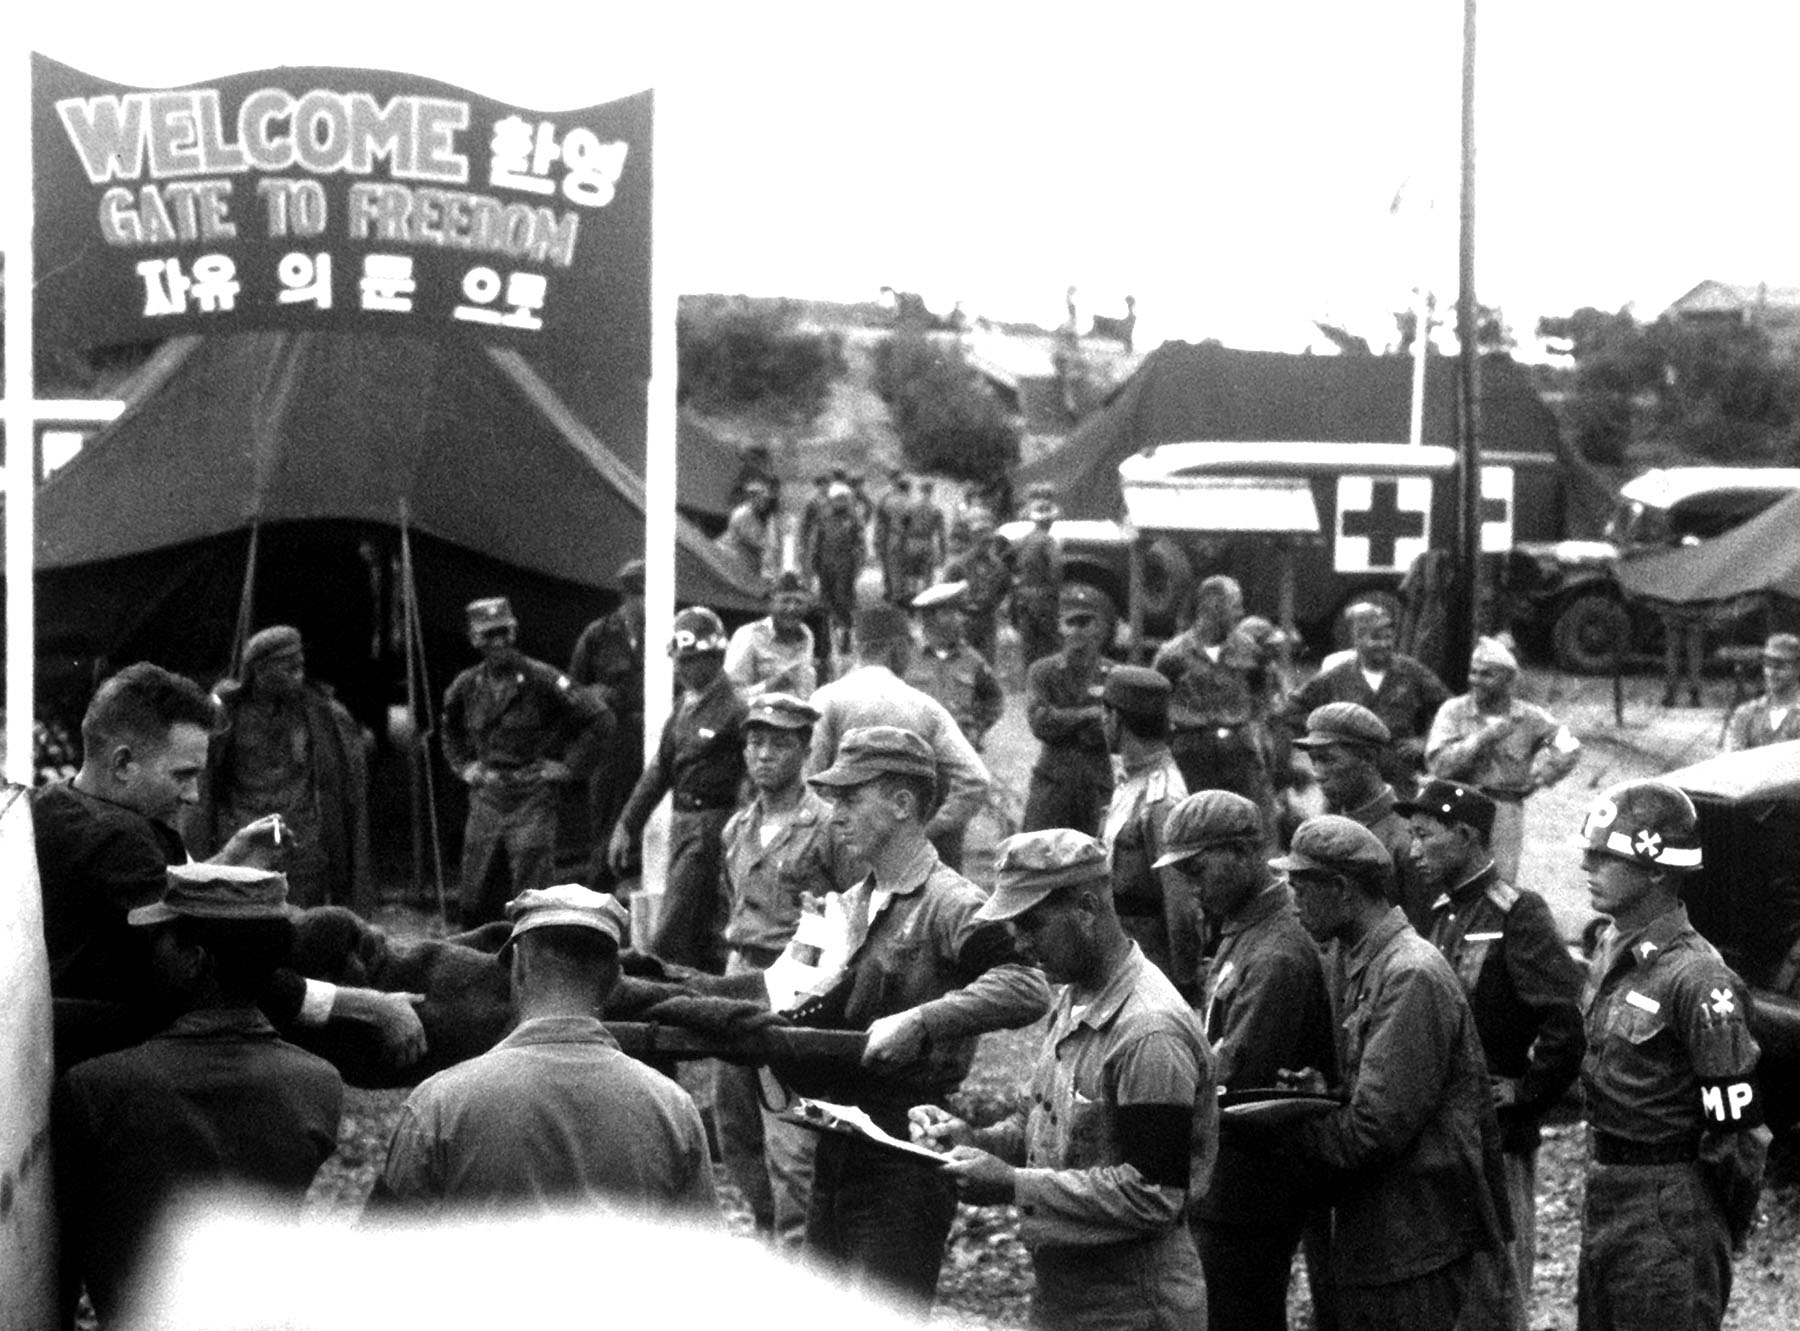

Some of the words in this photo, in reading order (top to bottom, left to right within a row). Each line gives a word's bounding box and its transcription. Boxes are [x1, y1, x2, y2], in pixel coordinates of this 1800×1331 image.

[56, 88, 470, 182] WELCOME
[490, 115, 629, 207] 환영
[100, 178, 236, 246] GATE
[256, 177, 328, 238] TO
[349, 182, 579, 266] FREEDOM
[1701, 1083, 1753, 1121] MP
